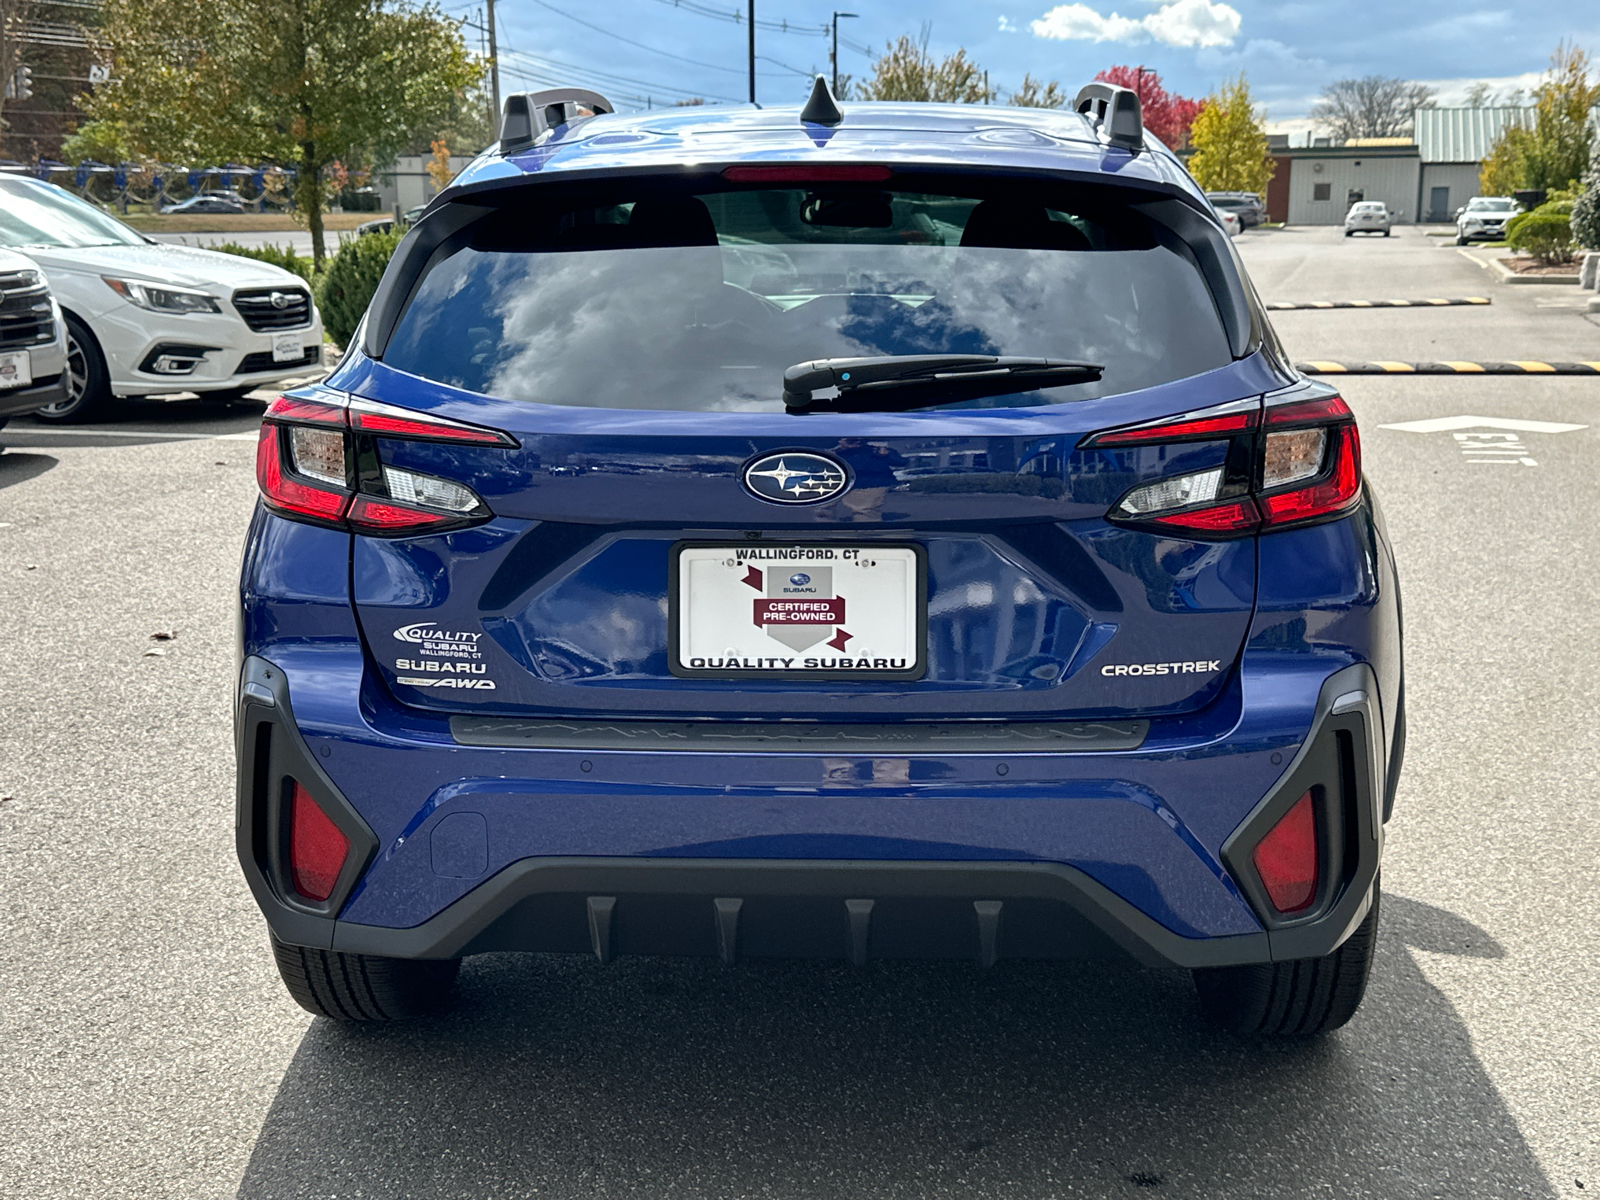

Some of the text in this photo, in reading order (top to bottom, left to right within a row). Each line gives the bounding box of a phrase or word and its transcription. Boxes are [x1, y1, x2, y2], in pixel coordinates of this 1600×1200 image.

[1453, 432, 1538, 467] EXIT
[843, 549, 860, 560] CT
[768, 602, 830, 612] CERTIFIED
[763, 612, 836, 621] PRE-OWNED
[408, 628, 482, 642] QUALITY
[423, 642, 477, 652] SUBARU
[419, 649, 471, 658] WALLINGFORD,
[395, 659, 486, 673] SUBARU
[690, 657, 906, 669] QUALITY SUBARU
[1101, 660, 1221, 676] CROSSTREK
[433, 678, 496, 689] AWD
